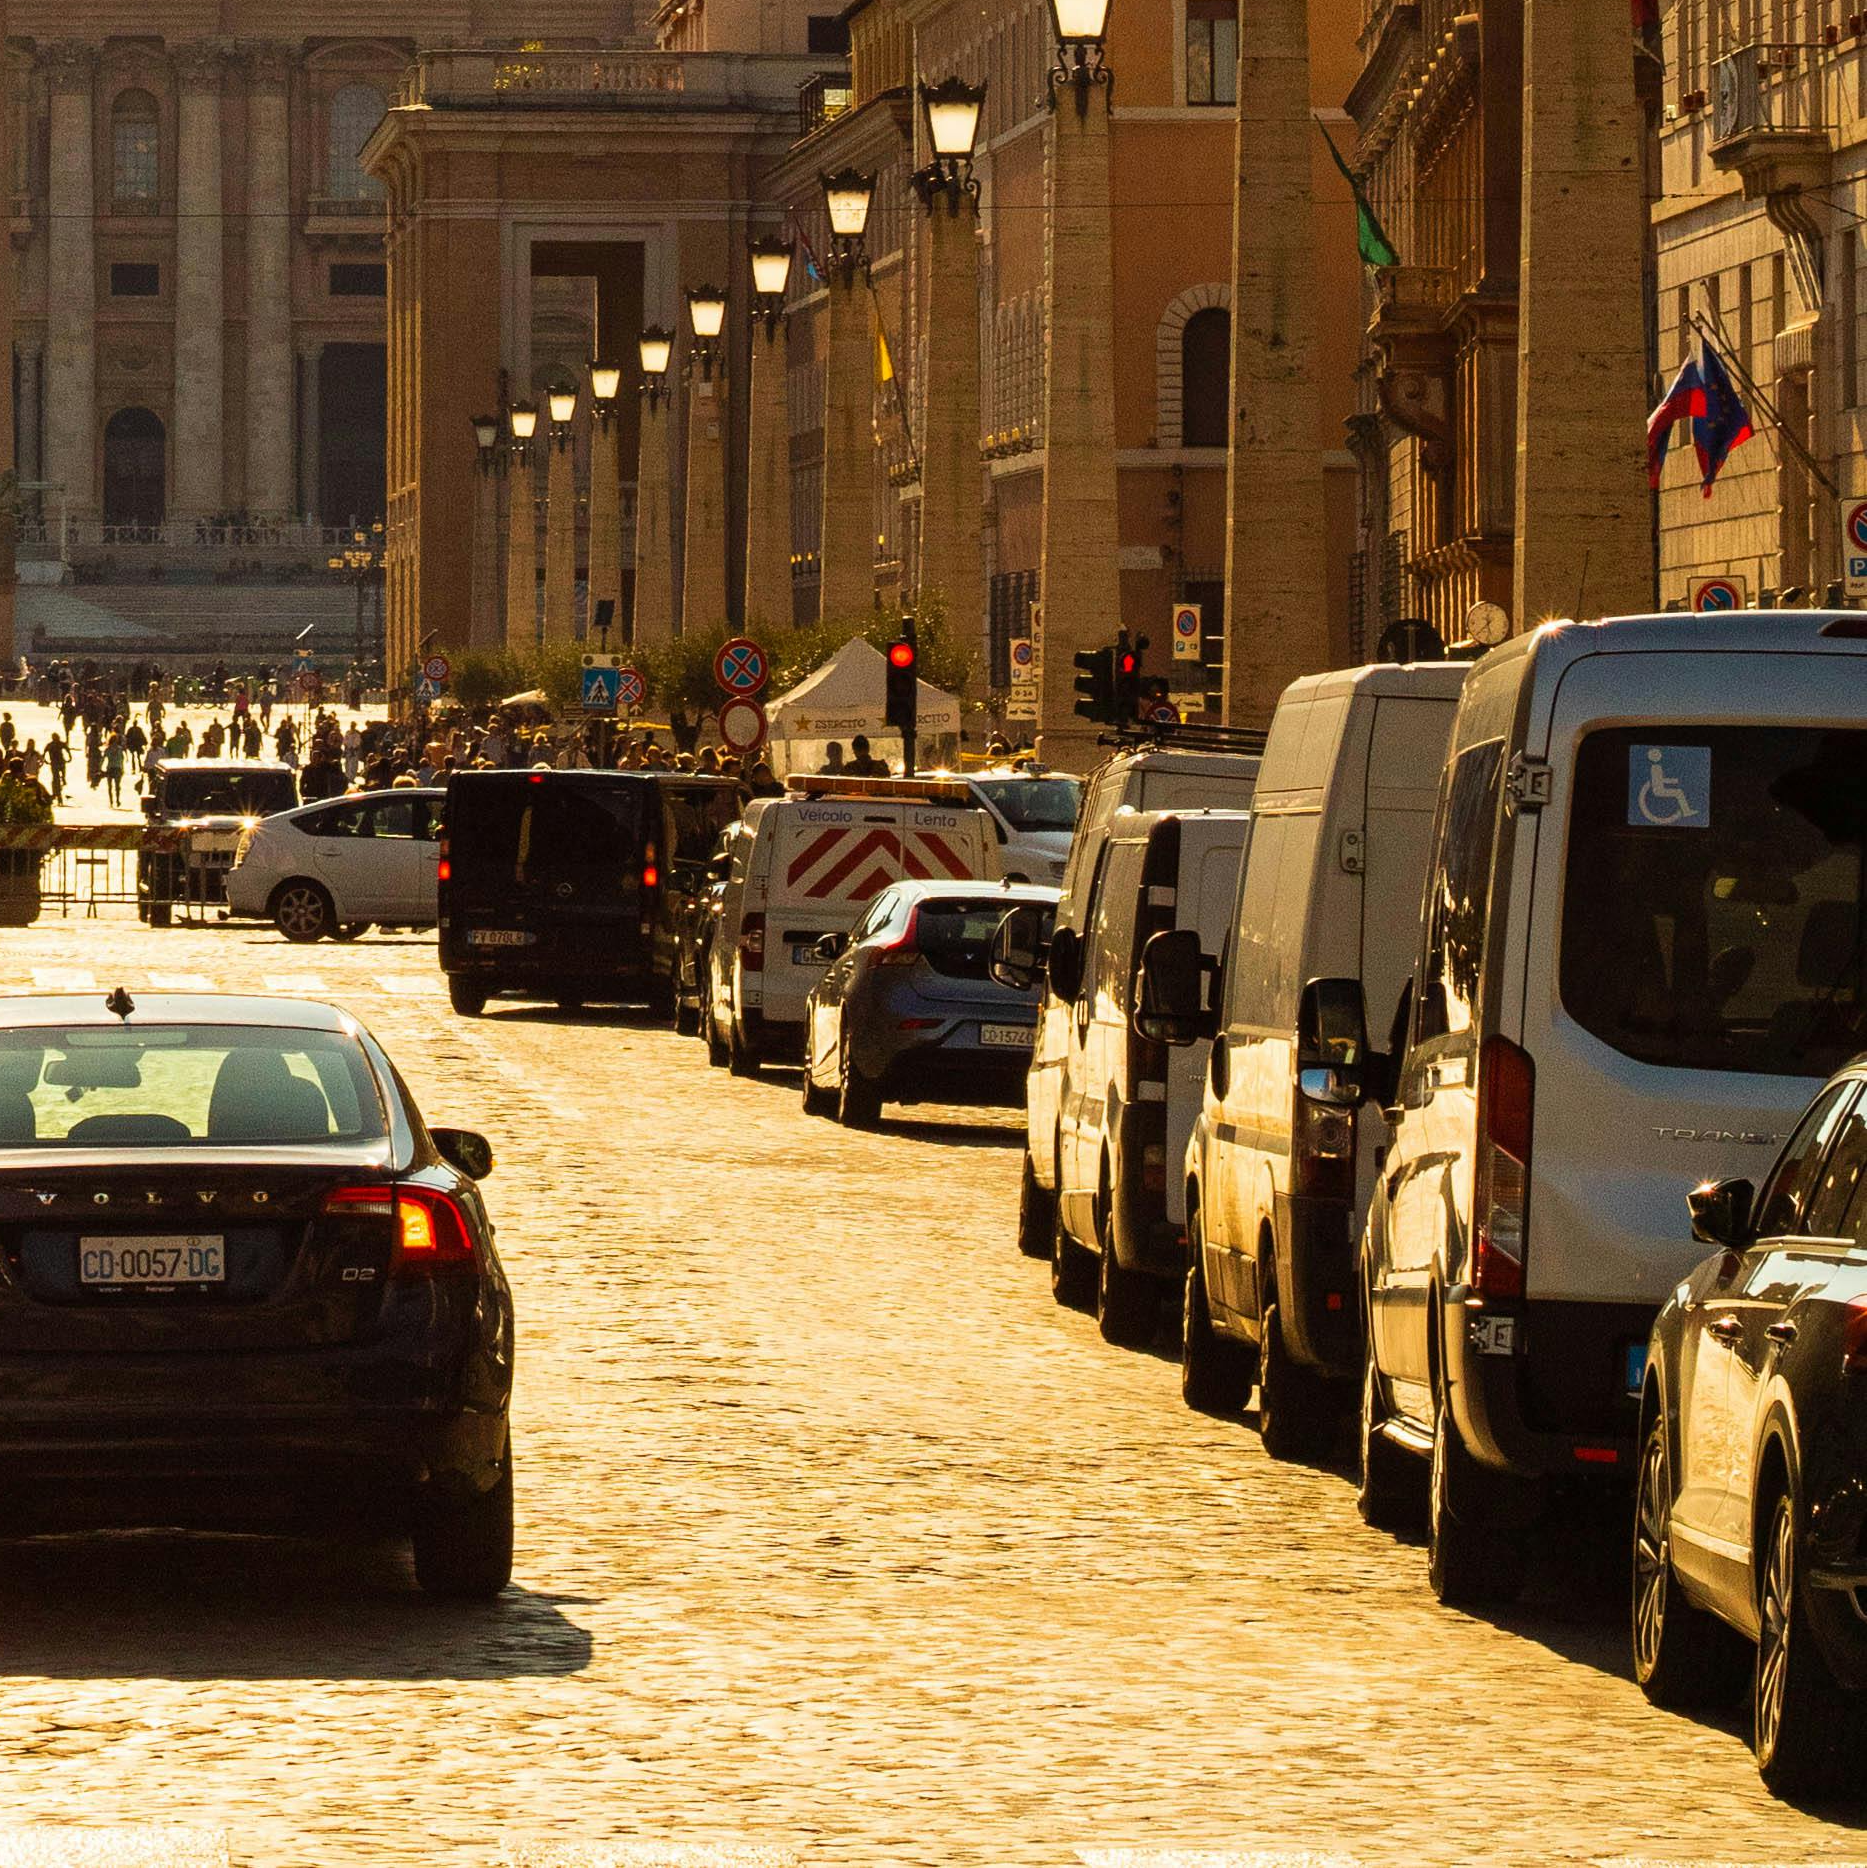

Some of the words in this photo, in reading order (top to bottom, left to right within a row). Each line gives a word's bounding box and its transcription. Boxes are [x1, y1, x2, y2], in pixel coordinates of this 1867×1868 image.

[814, 718, 867, 730] ESERCITO
[916, 713, 951, 725] RCITO
[798, 808, 853, 823] Veicolo
[915, 811, 957, 828] Lento
[35, 1190, 270, 1205] VOLVO
[342, 1267, 376, 1281] D2
